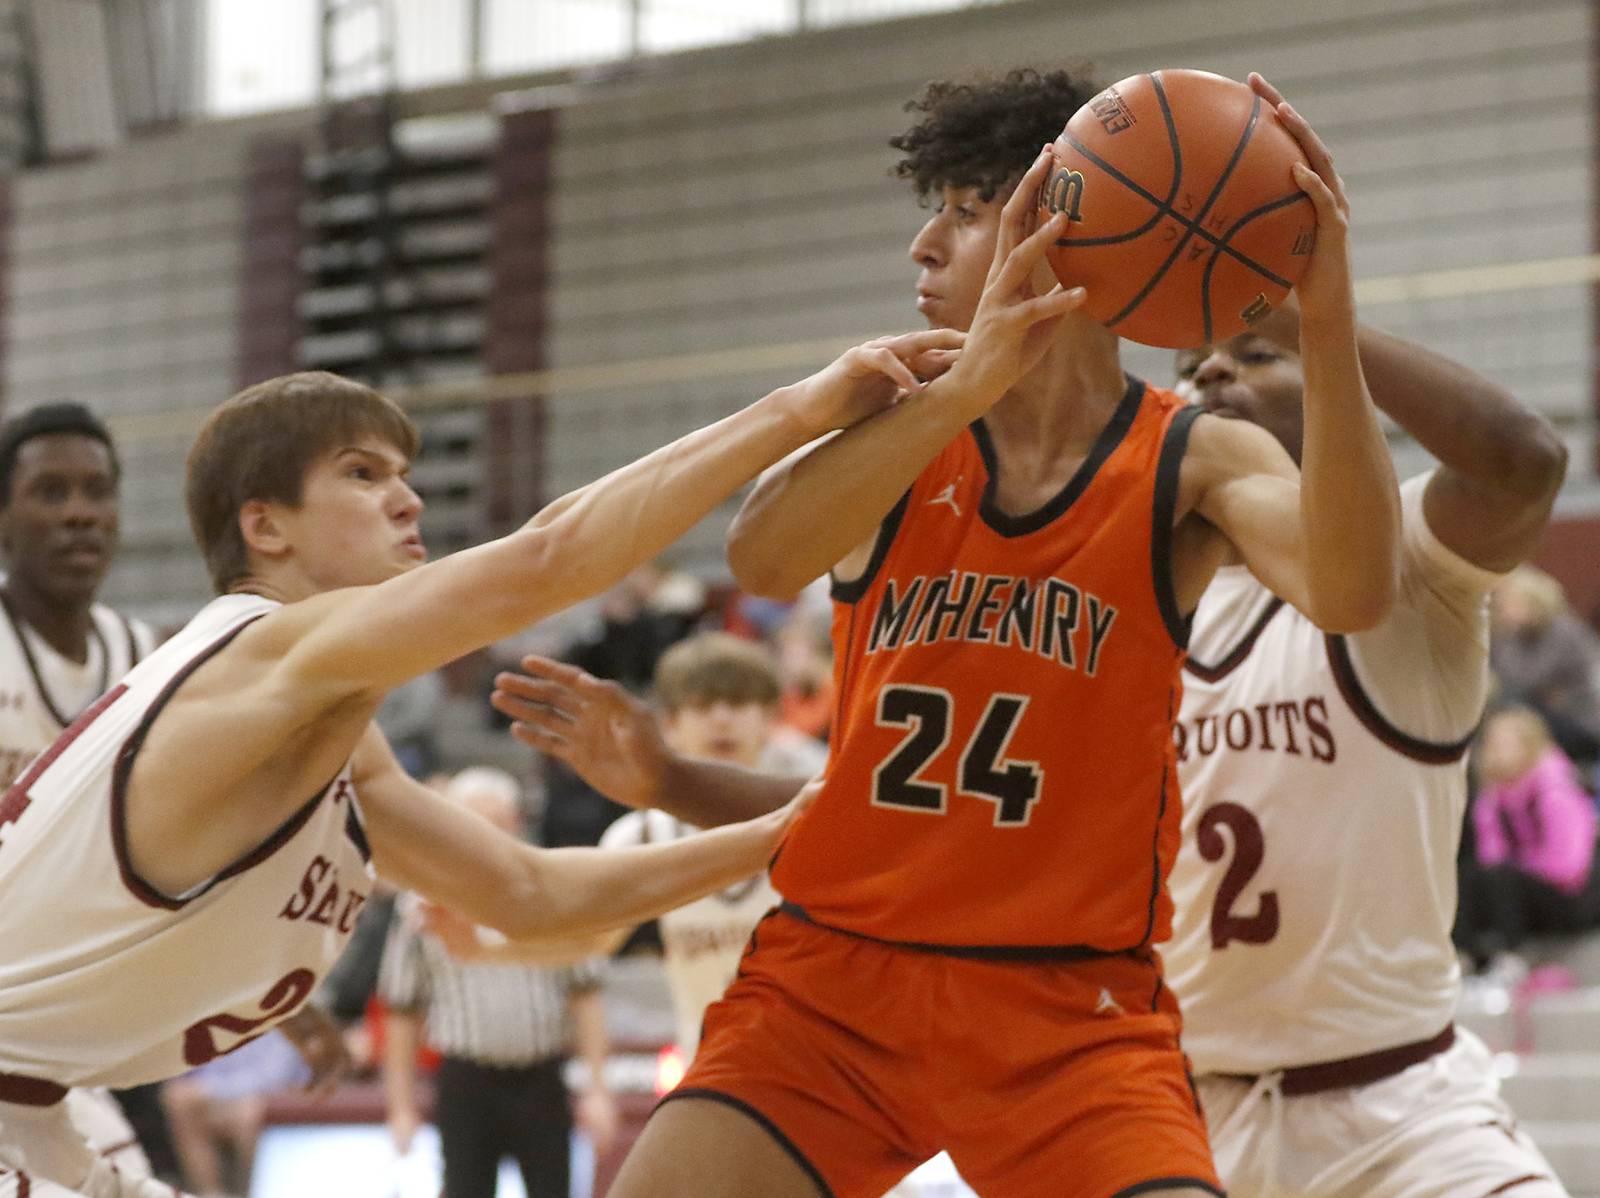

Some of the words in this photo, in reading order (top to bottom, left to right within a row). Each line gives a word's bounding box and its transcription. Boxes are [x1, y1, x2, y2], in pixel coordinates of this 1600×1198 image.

[870, 683, 1045, 828] 24
[1197, 802, 1281, 950] 2
[183, 968, 316, 1066] 2
